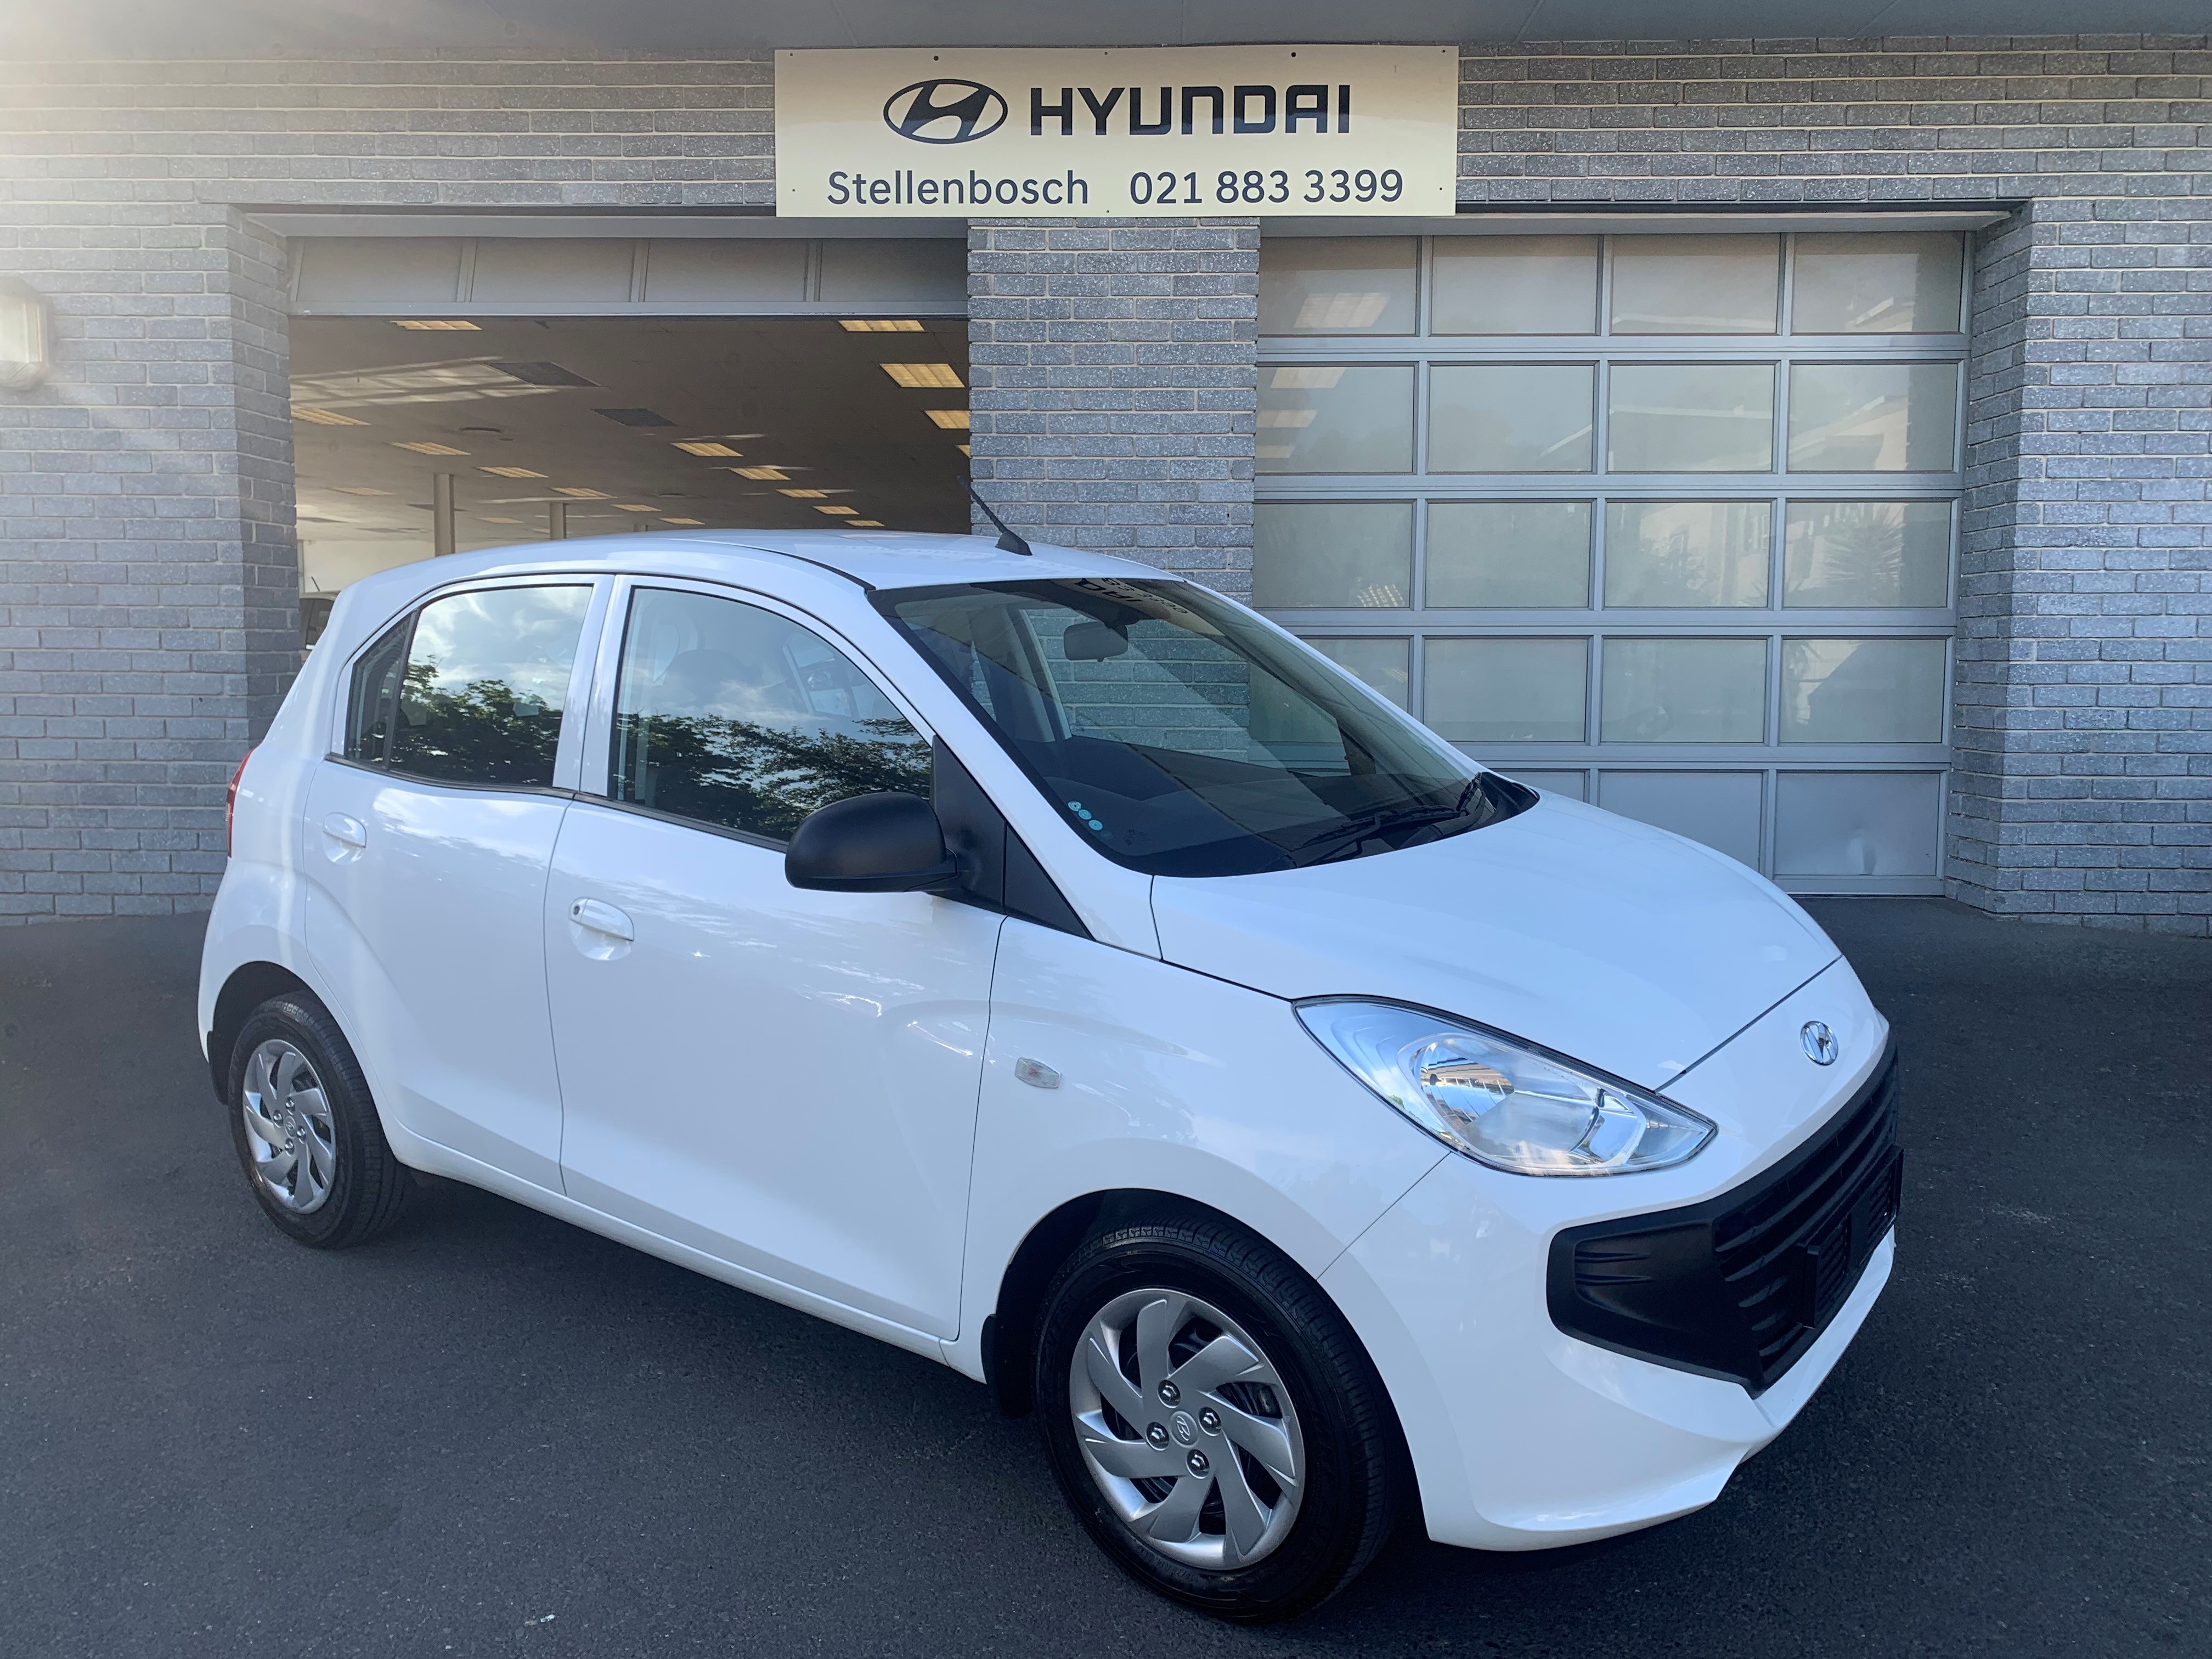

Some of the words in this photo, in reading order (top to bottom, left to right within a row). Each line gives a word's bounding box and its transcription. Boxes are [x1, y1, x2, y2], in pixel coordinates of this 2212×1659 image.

[1030, 84, 1350, 136] HYUNDAI
[827, 170, 1088, 205] Stellenbosch
[1130, 171, 1203, 205] 021
[1216, 170, 1290, 204] 883
[1304, 168, 1403, 202] 3399
